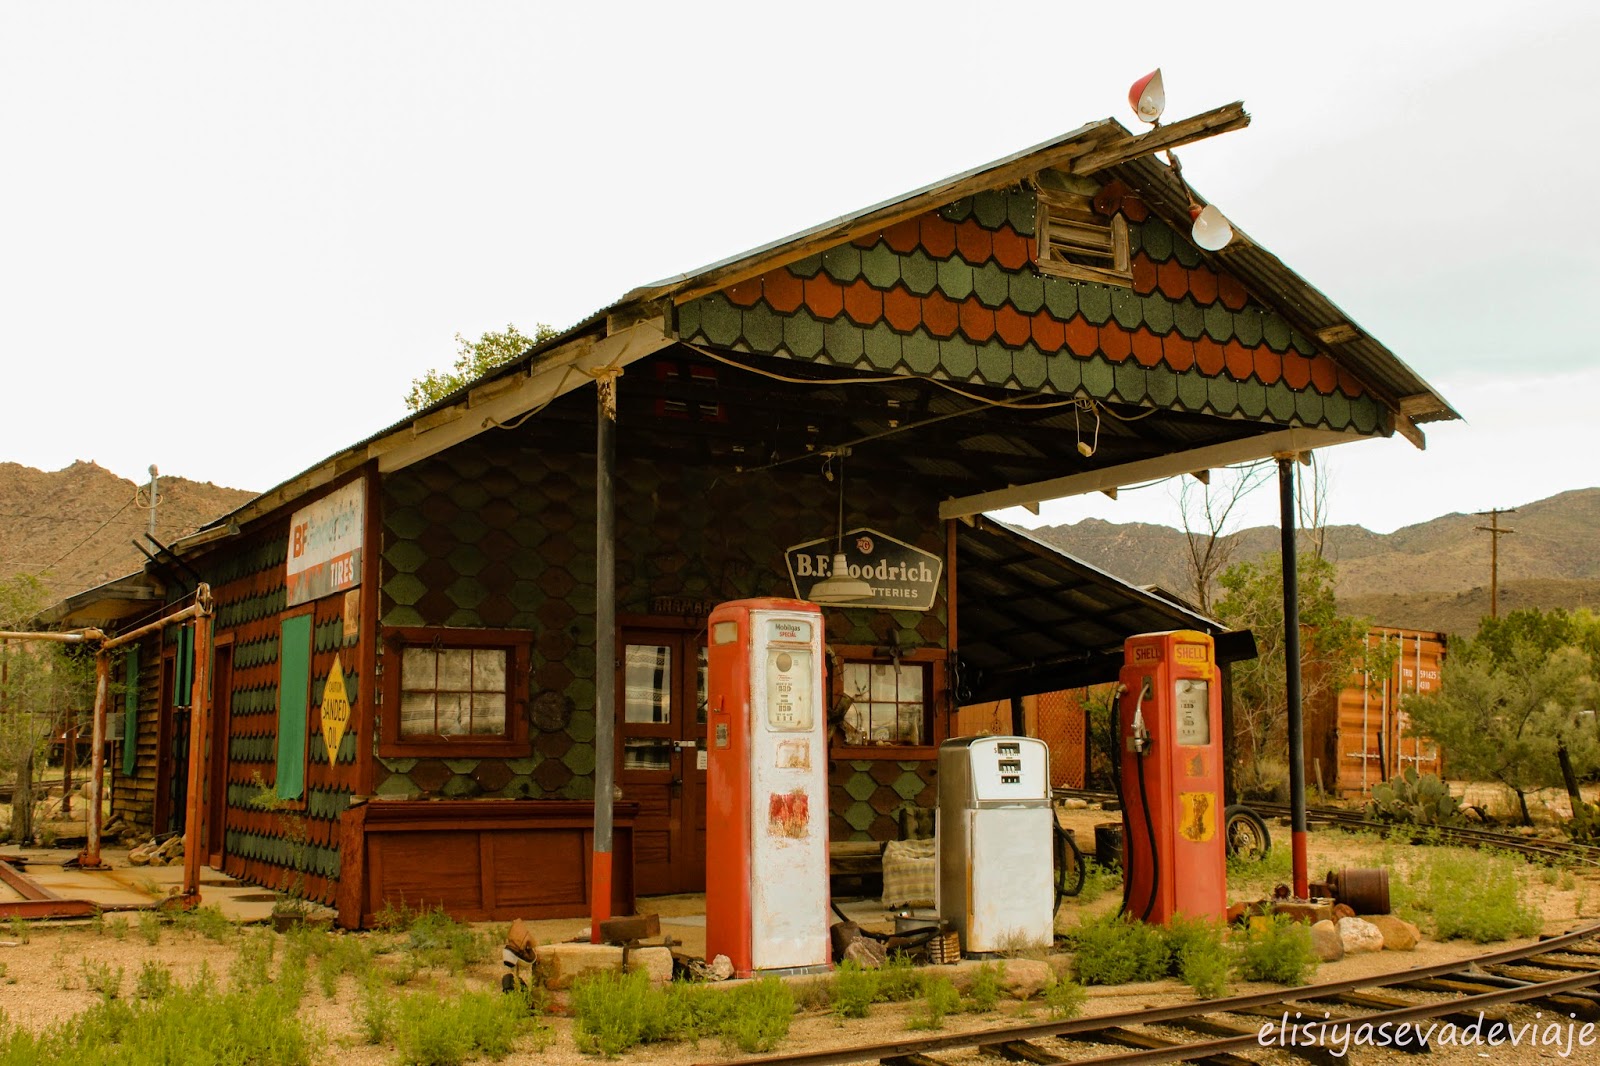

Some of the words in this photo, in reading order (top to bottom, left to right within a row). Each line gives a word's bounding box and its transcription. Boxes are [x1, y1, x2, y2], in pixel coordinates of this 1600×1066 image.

[331, 555, 354, 588] TIRES
[797, 554, 832, 577] B.F.
[846, 559, 932, 582] oodrich
[871, 587, 919, 599] TTERIES
[775, 624, 800, 632] Mobilgas
[1136, 648, 1160, 660] SHELL
[1176, 648, 1204, 659] SHELL
[322, 699, 347, 722] SANDED
[328, 726, 337, 750] OIL
